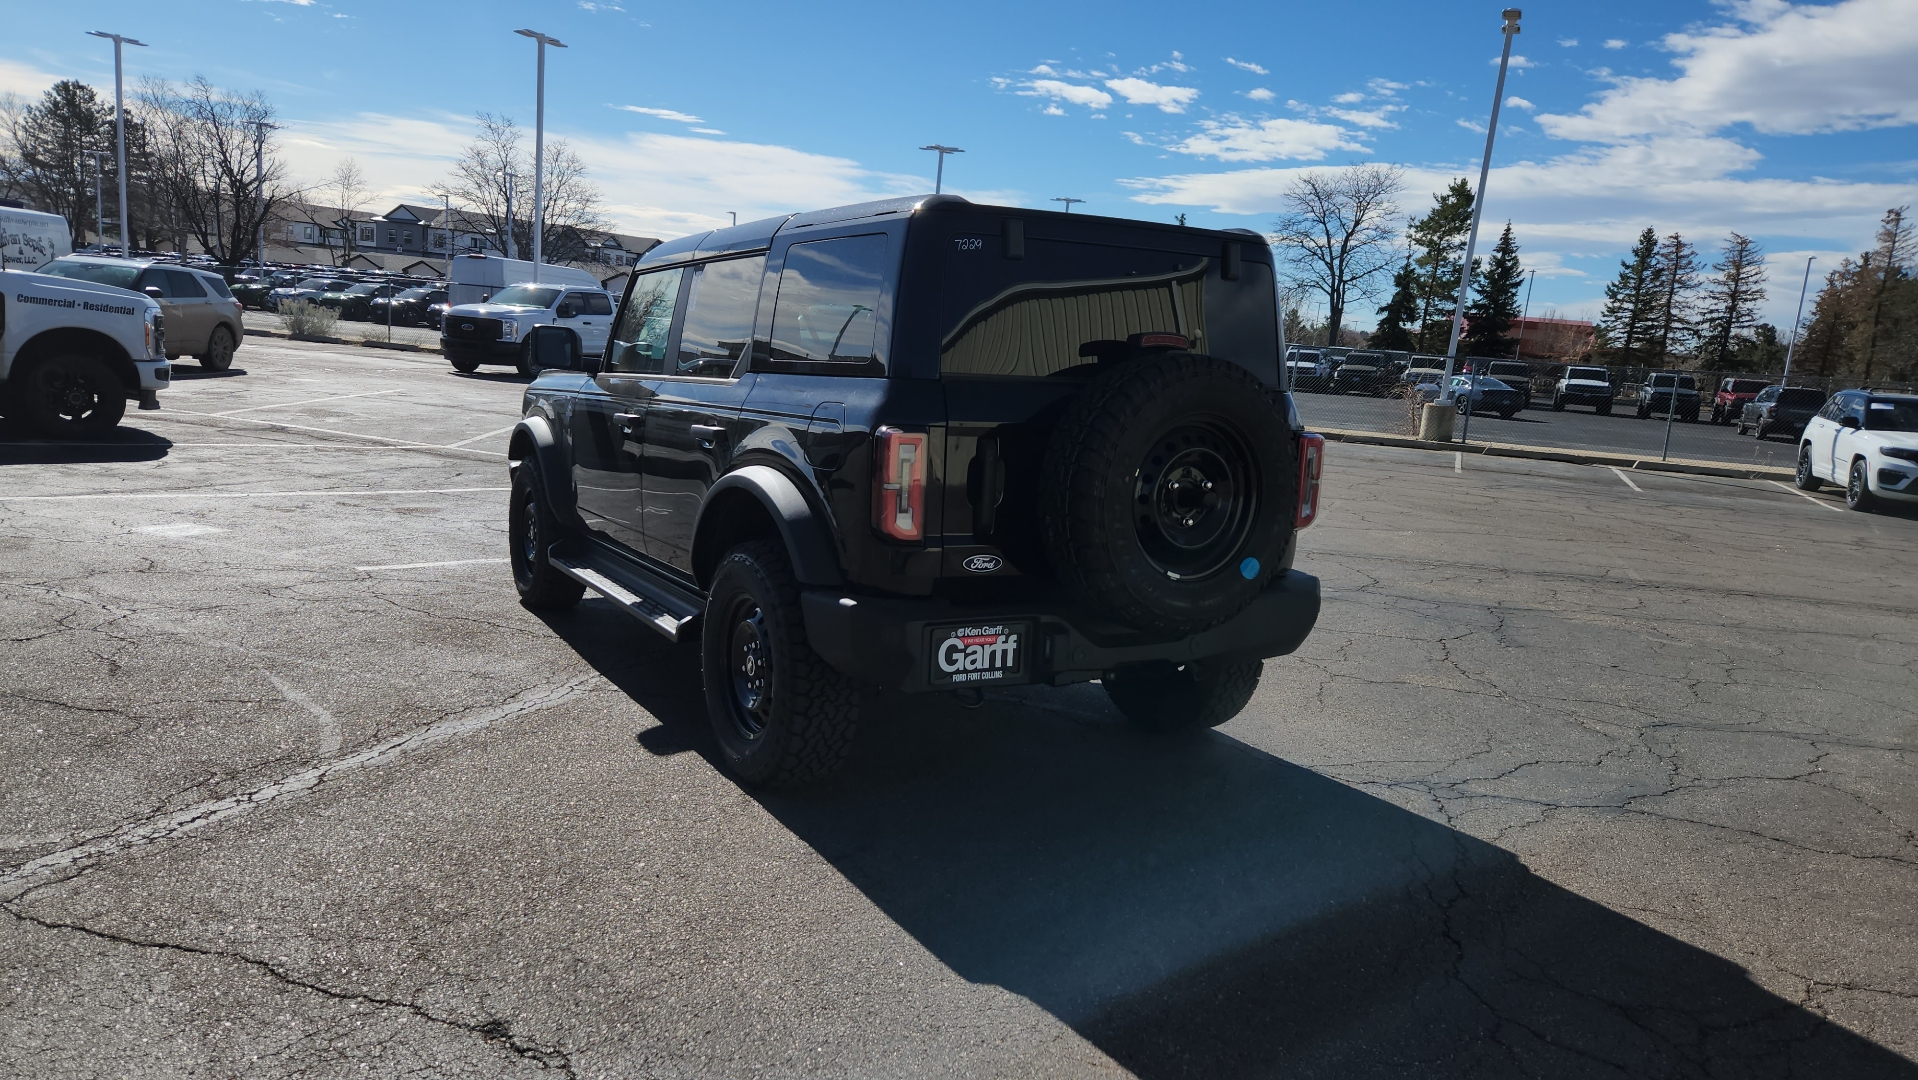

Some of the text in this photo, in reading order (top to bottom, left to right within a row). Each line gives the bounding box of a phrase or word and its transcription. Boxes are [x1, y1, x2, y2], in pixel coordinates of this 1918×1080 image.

[954, 238, 983, 251] 7229
[16, 293, 135, 316] Commercial Residential
[970, 557, 996, 569] Ford
[965, 625, 1003, 637] Ken Garff
[938, 634, 1018, 673] Garff
[952, 670, 1003, 682] FORD FORT COLLINS
